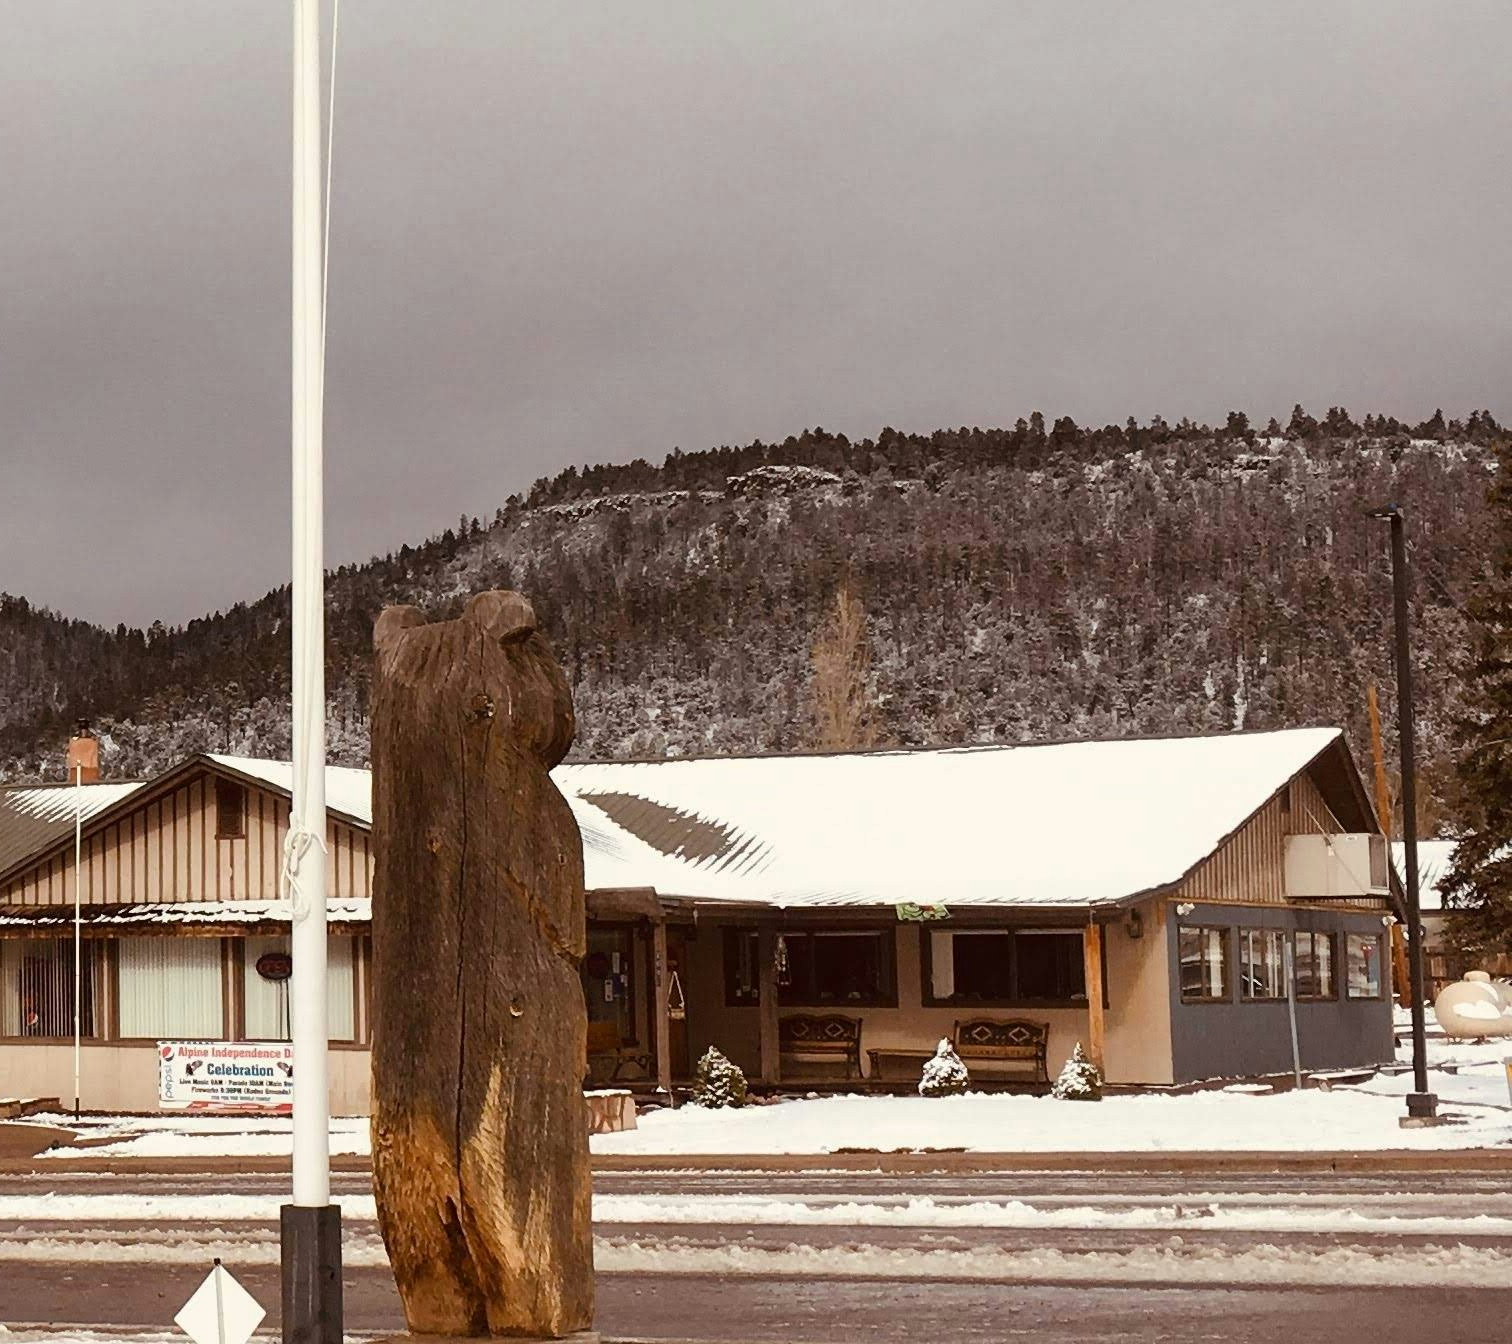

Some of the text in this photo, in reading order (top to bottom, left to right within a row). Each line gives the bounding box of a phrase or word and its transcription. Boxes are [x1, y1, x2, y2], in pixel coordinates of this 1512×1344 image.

[178, 1047, 208, 1059] Alpine
[212, 1047, 281, 1059] Independence
[207, 1063, 274, 1076] Celebration
